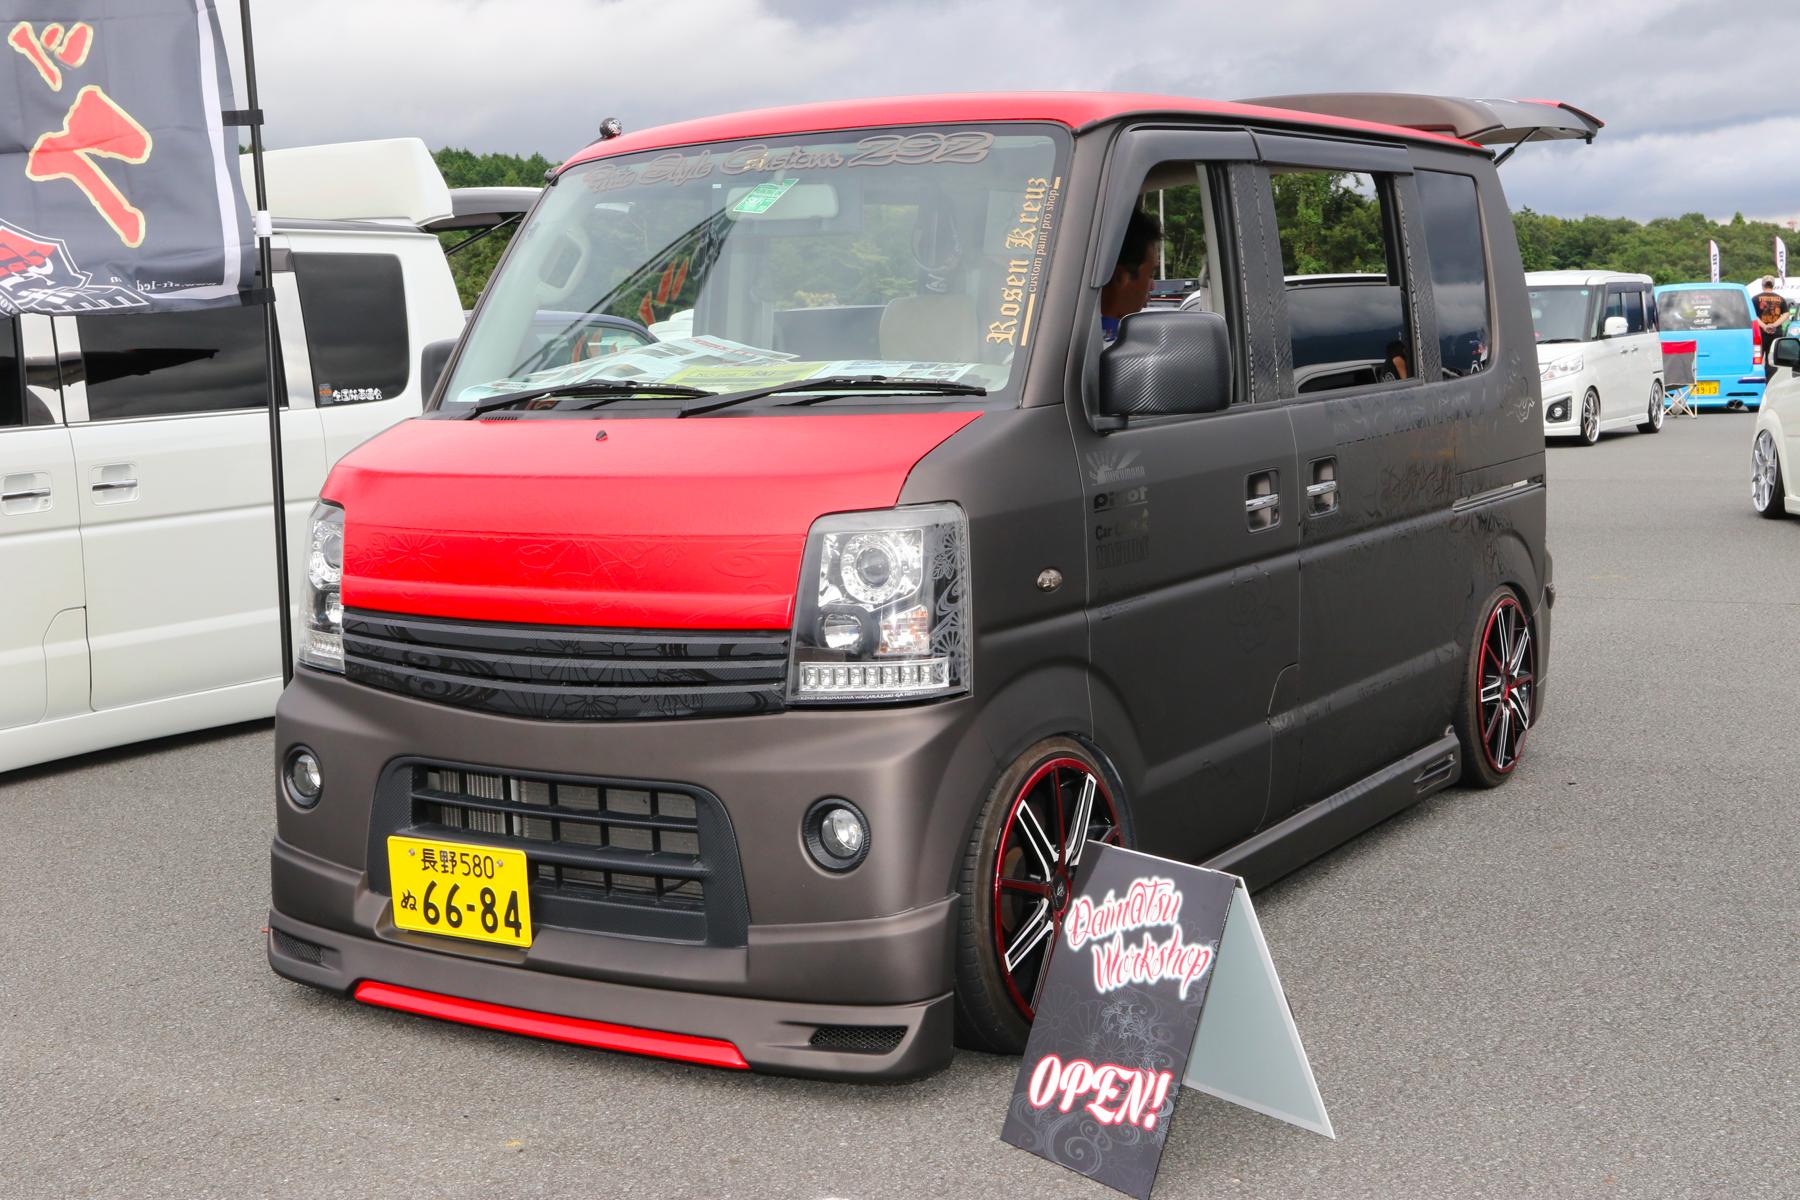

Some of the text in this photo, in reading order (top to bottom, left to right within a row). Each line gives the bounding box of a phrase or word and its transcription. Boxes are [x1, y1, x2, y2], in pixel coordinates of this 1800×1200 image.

[1029, 189, 1060, 293] custom paint pro shop
[986, 258, 1030, 345] Rosen
[1093, 486, 1148, 509] piot
[400, 880, 522, 938] ぬ 66-84
[1092, 925, 1213, 999] Workshop
[1029, 1054, 1173, 1130] OPEN!
